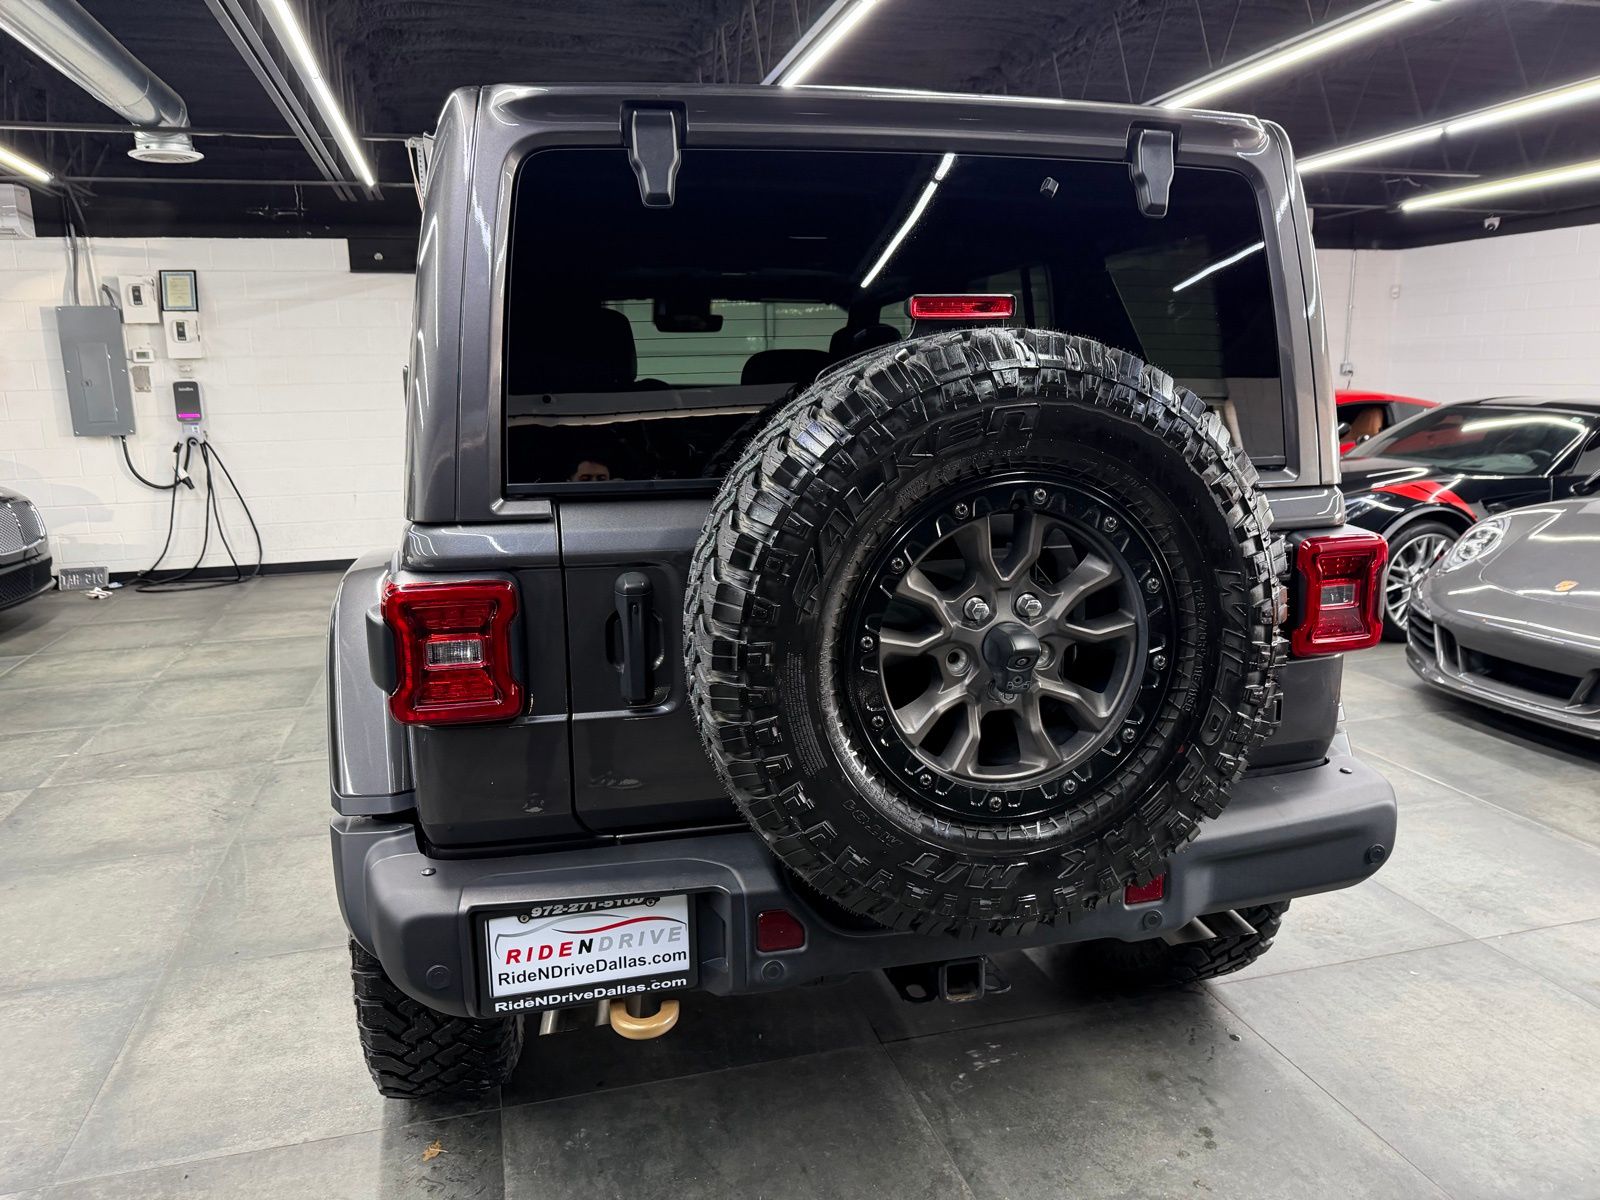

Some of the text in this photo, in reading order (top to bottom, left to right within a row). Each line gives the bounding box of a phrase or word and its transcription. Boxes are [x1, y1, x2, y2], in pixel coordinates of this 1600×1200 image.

[792, 402, 1041, 624] FALKEN
[898, 568, 1247, 889] WILDPEAK M/T
[531, 897, 645, 917] 972-271-5100
[498, 950, 687, 986] RideNDriveDallas.com
[495, 977, 687, 1012] RideNDriveDallas.com
